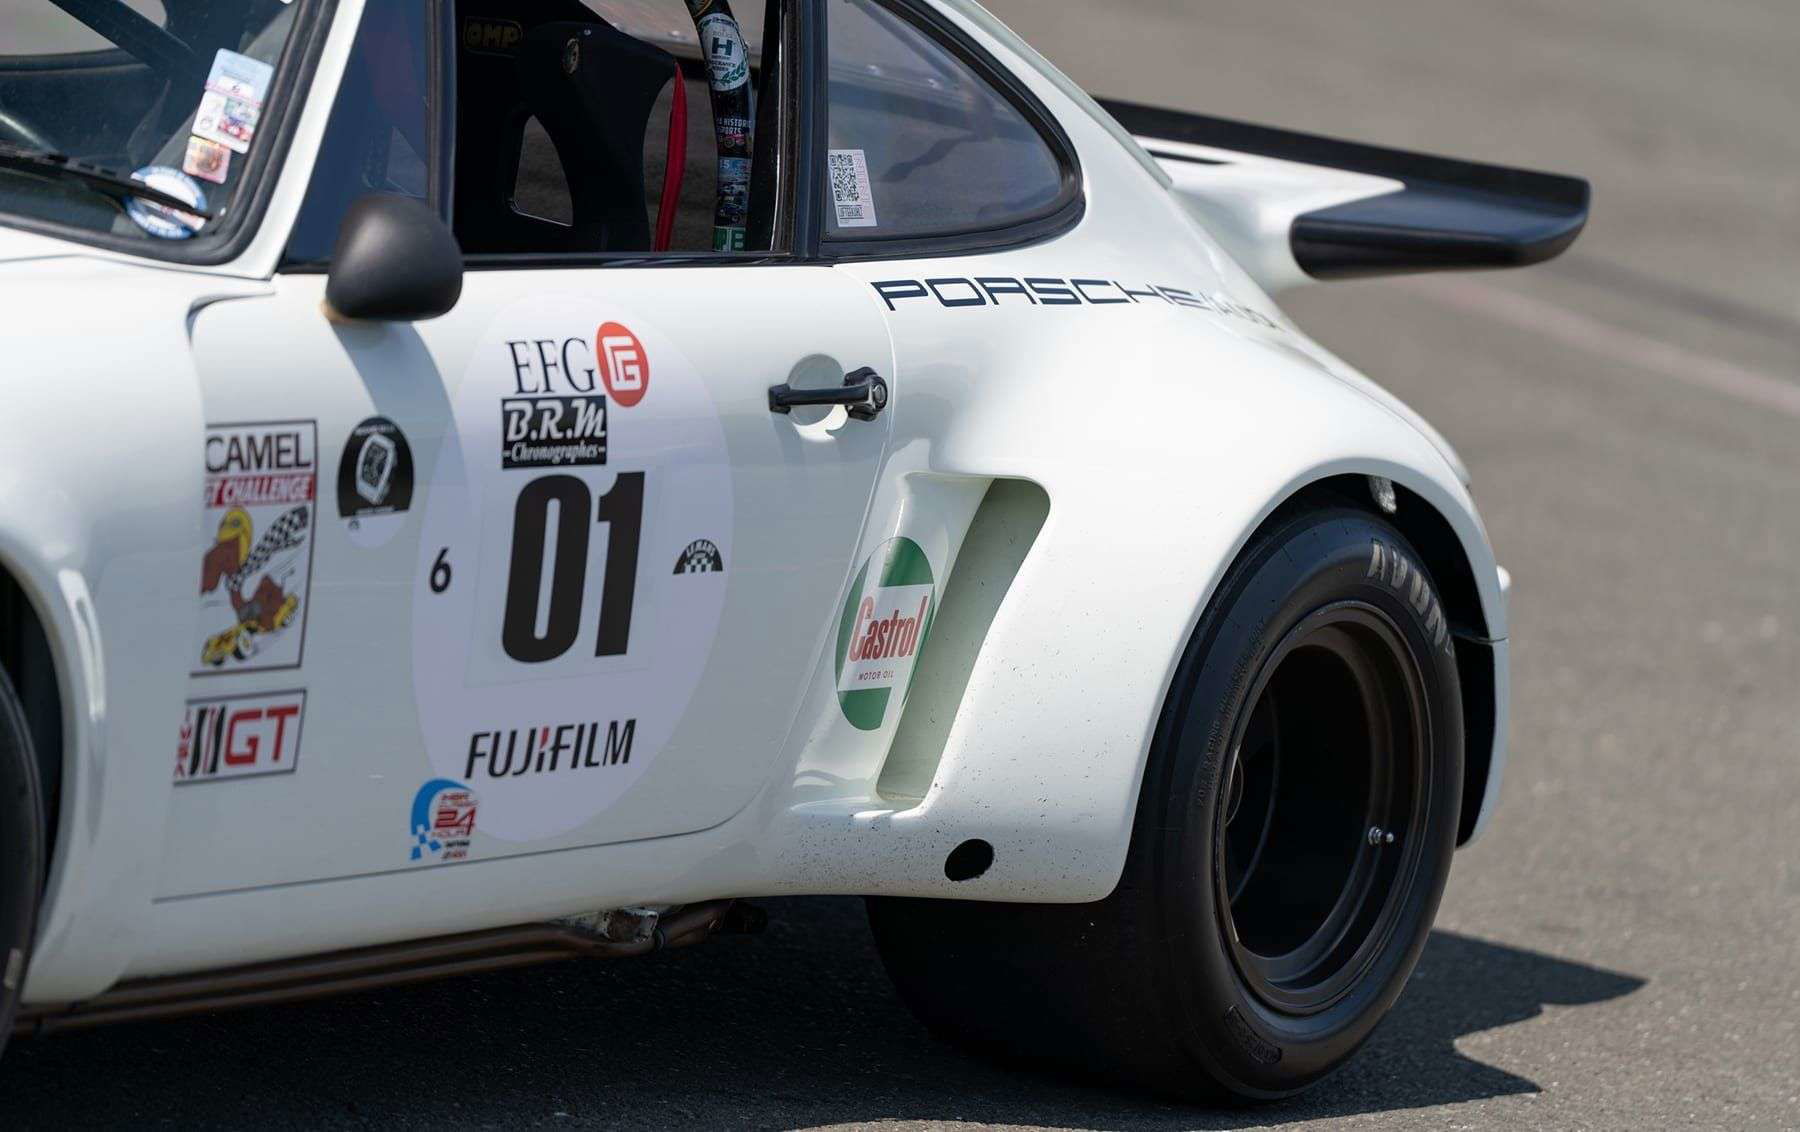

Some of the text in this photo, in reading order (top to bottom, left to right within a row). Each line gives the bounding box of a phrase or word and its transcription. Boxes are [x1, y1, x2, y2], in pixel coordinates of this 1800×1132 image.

[870, 277, 1211, 312] PORSCHE
[505, 337, 596, 395] EFG
[205, 432, 311, 474] CAMEL
[430, 546, 451, 594] 6
[502, 471, 645, 663] 01
[849, 595, 928, 662] Castrol
[858, 671, 881, 681] MOTOR
[224, 704, 299, 767] GT
[464, 718, 637, 780] FUJIFILM
[434, 806, 476, 836] 24
